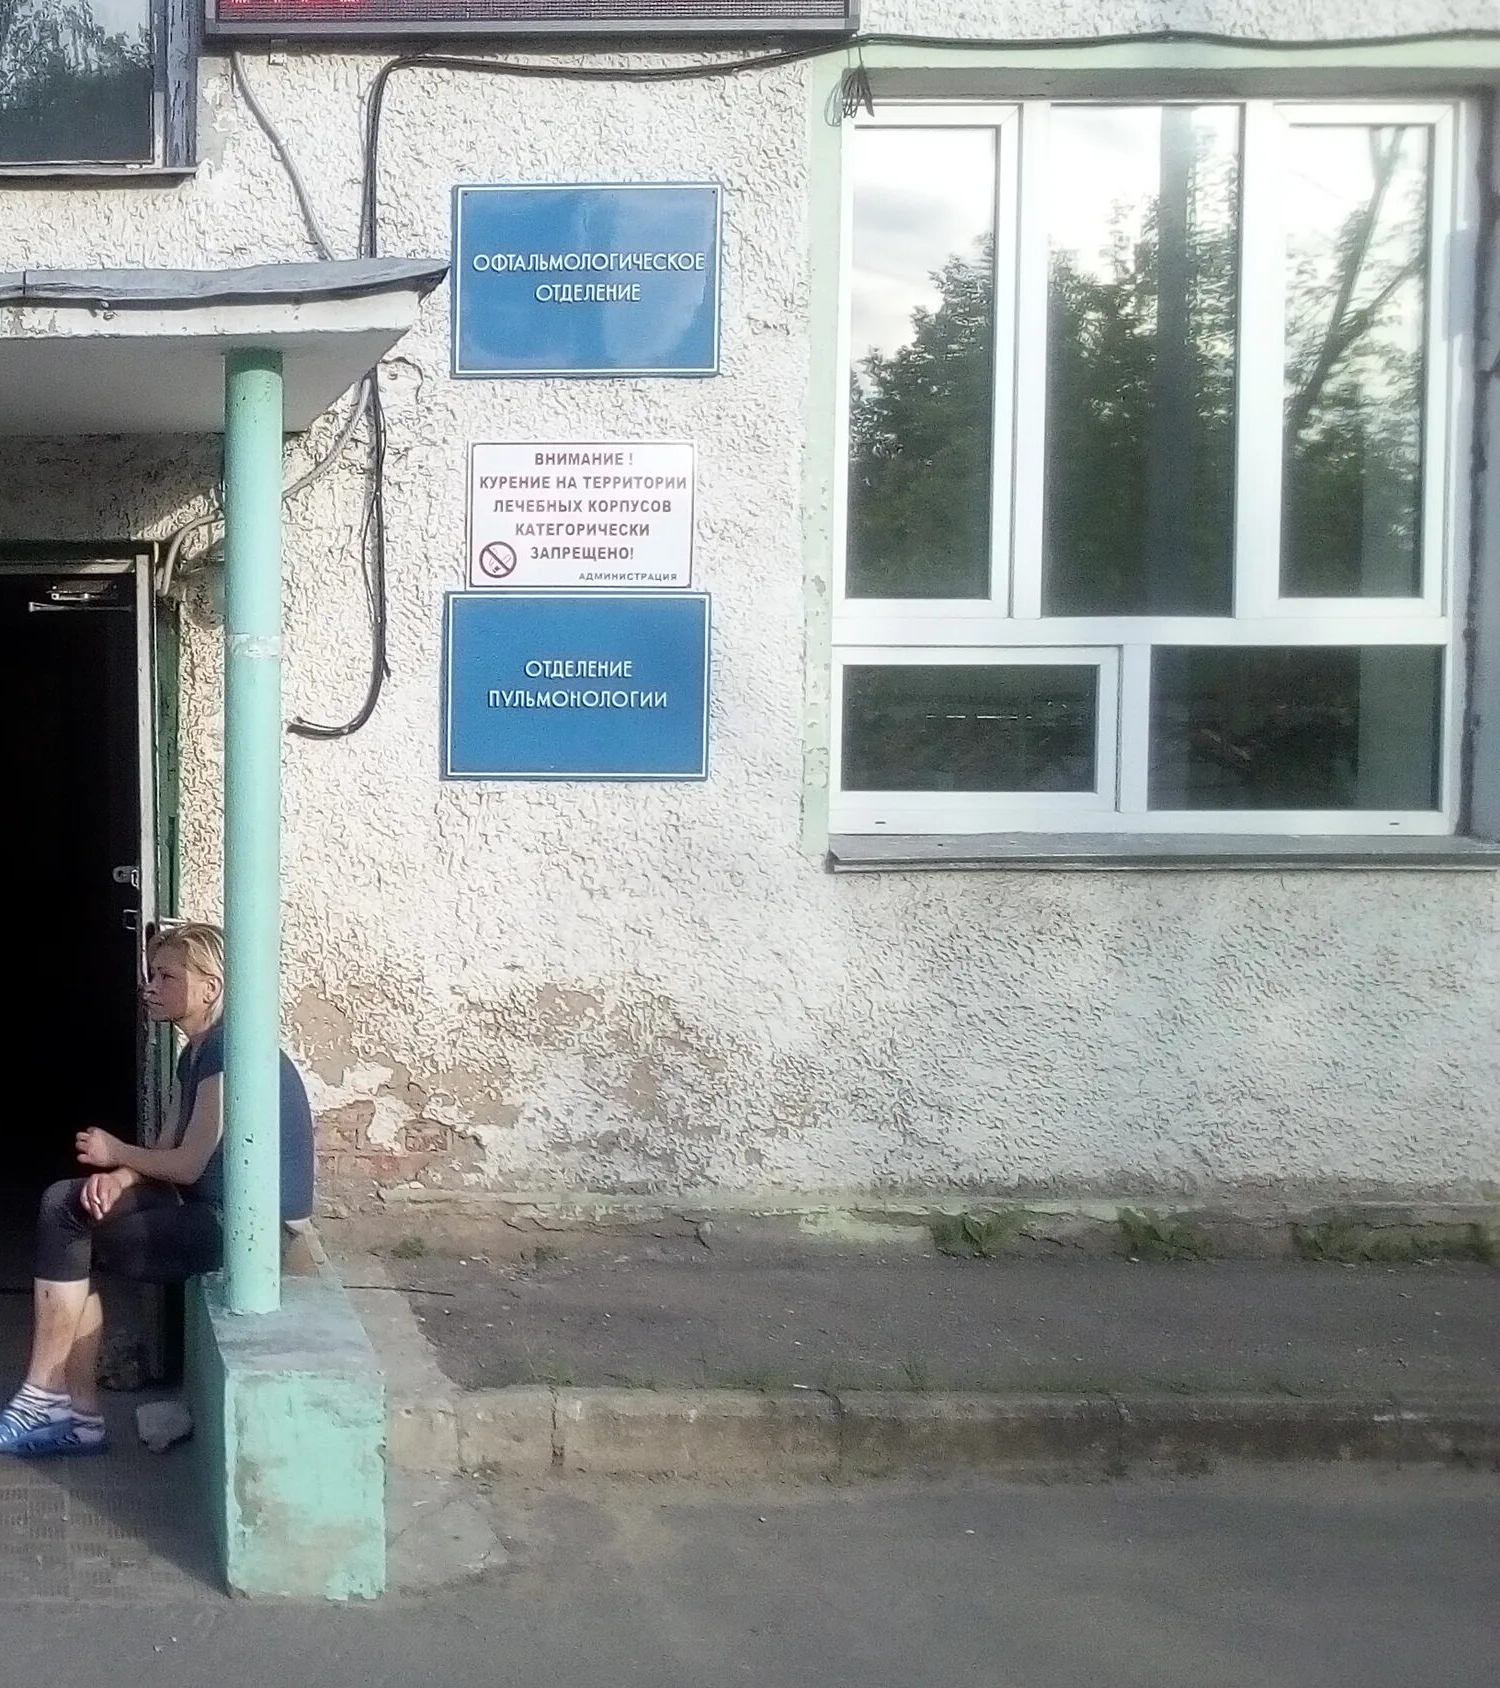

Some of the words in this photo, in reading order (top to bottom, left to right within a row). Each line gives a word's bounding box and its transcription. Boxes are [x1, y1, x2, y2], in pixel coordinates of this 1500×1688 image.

[473, 252, 706, 273] ОФТАЛЬМОЛОГИЧЕСКОЕ
[535, 283, 641, 303] ОТДЕЛЕНИЕ
[534, 452, 623, 466] ВНИМАНИЕ
[479, 476, 551, 489] КУРЕНИЕ
[556, 476, 578, 489] НА
[582, 476, 687, 489] ТЕРРИТОРИИ
[493, 499, 583, 513] ЛЕЧЕБНЫХ
[588, 499, 672, 513] КОРПУСОВ
[515, 523, 650, 537] КАТЕГОРИЧЕСКИ
[530, 546, 634, 562] ЗАПРЕЩЕНО!
[578, 572, 677, 582] АДМИНИСТРАЦИЯ
[525, 660, 632, 679] ОТДЕЛЕНИЕ
[489, 689, 667, 708] ПУЛЬМОНОЛОГИИ
